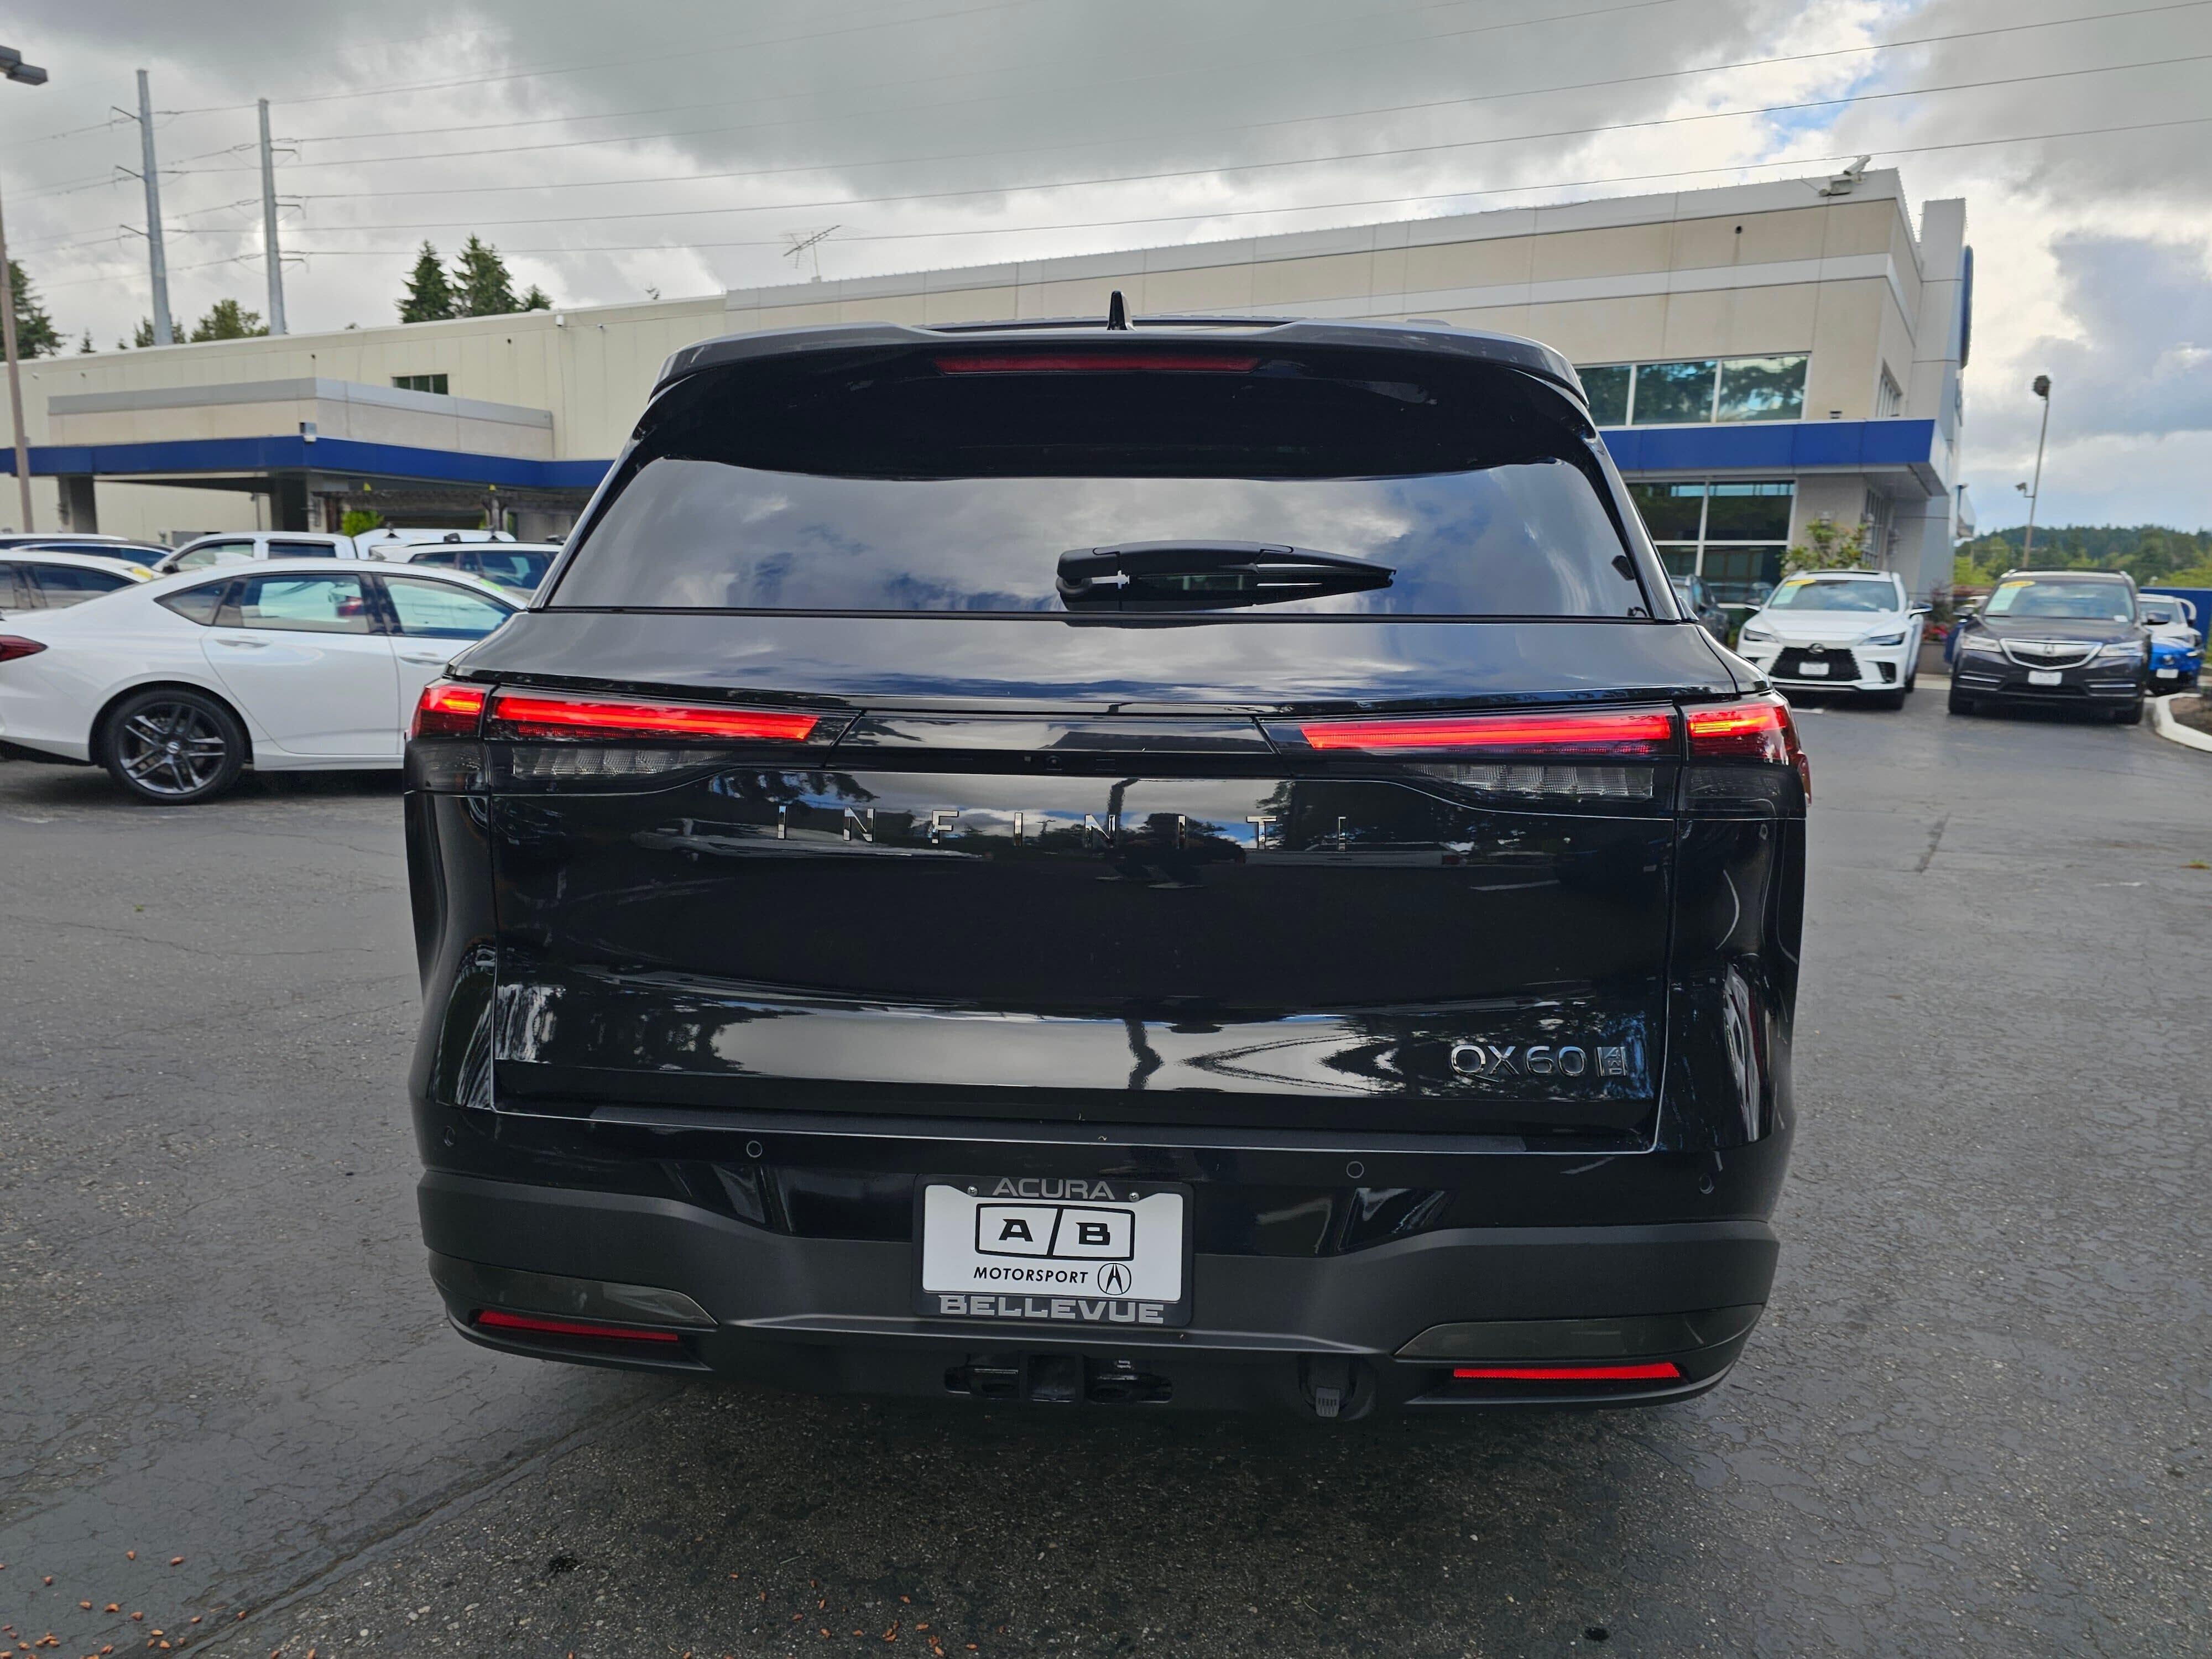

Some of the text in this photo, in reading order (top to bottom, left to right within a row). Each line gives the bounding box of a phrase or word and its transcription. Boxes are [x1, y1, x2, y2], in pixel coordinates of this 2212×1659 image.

[776, 805, 1347, 851] INFINITI
[1451, 1045, 1586, 1083] QX60
[992, 1177, 1115, 1201] ACURA
[998, 1218, 1110, 1245] A B
[973, 1266, 1088, 1284] MOTORSPORT
[938, 1295, 1164, 1324] BELLEVUE
